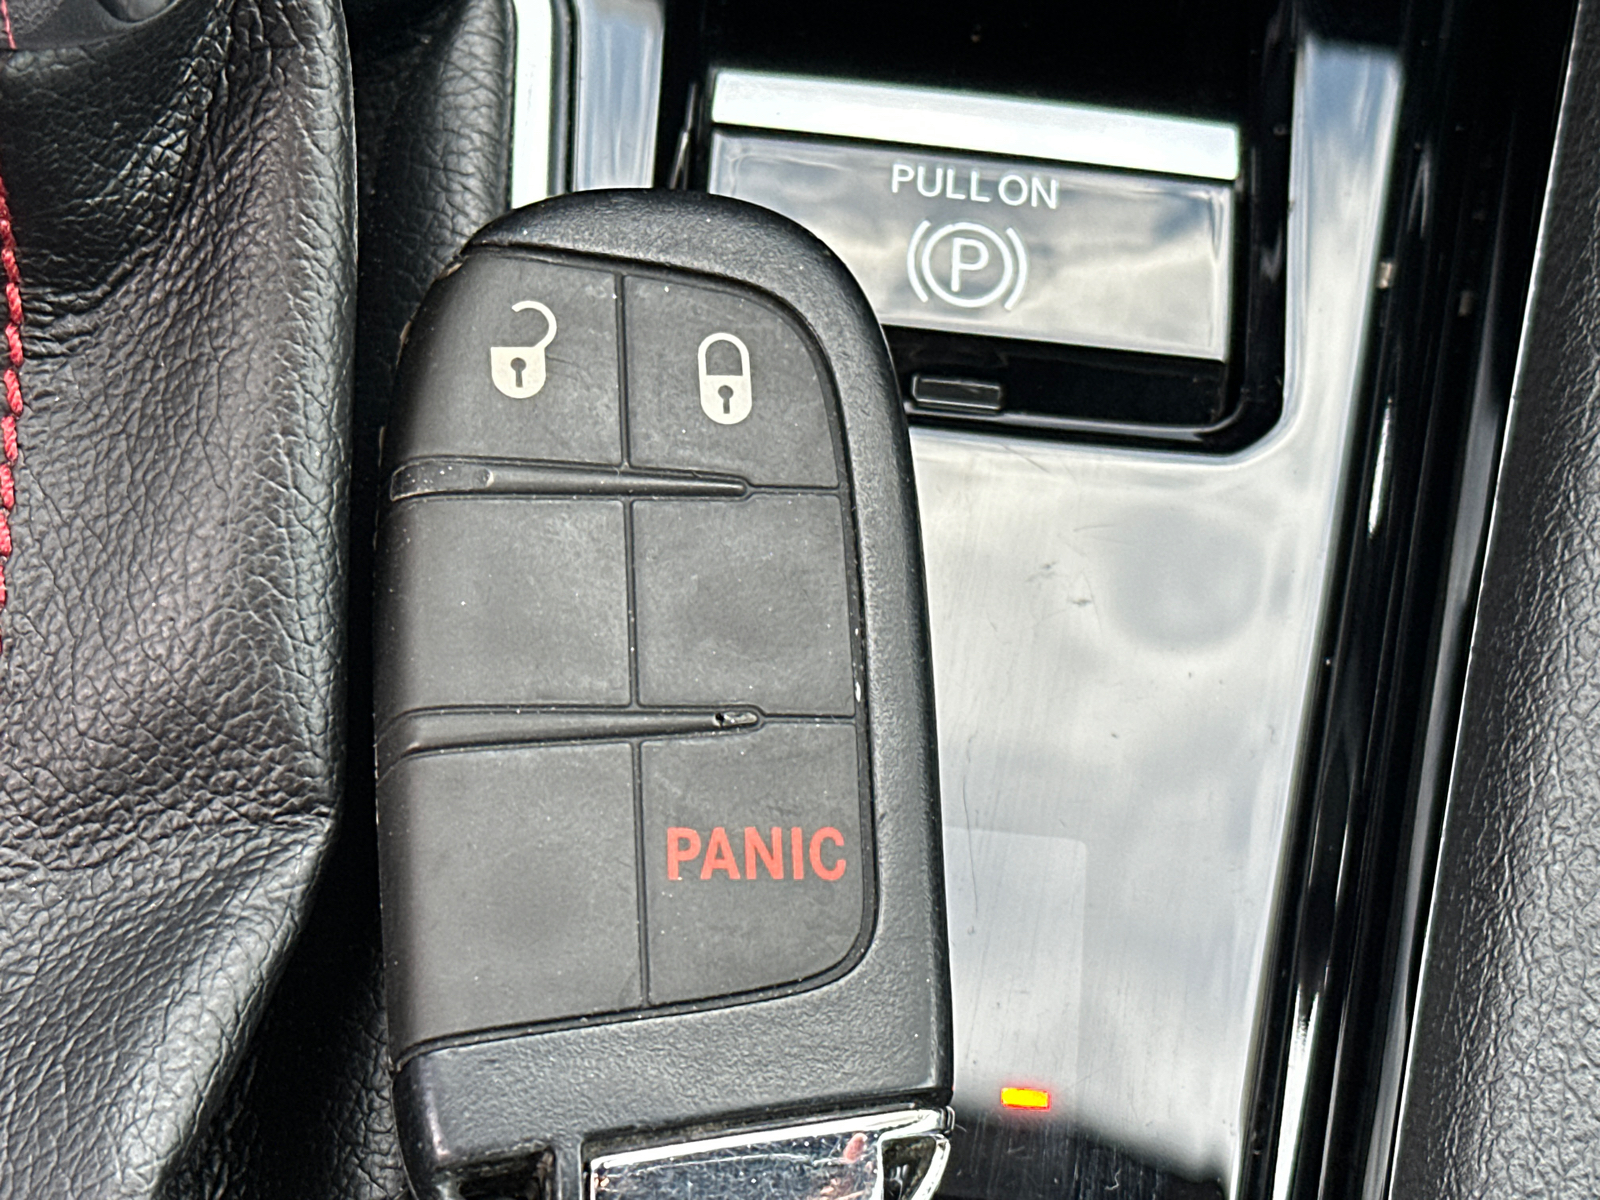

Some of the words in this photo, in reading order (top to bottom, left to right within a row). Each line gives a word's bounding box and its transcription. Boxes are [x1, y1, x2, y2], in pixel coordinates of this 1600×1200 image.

[891, 163, 991, 203] PULL
[998, 174, 1057, 210] ON
[666, 826, 847, 881] PANIC
